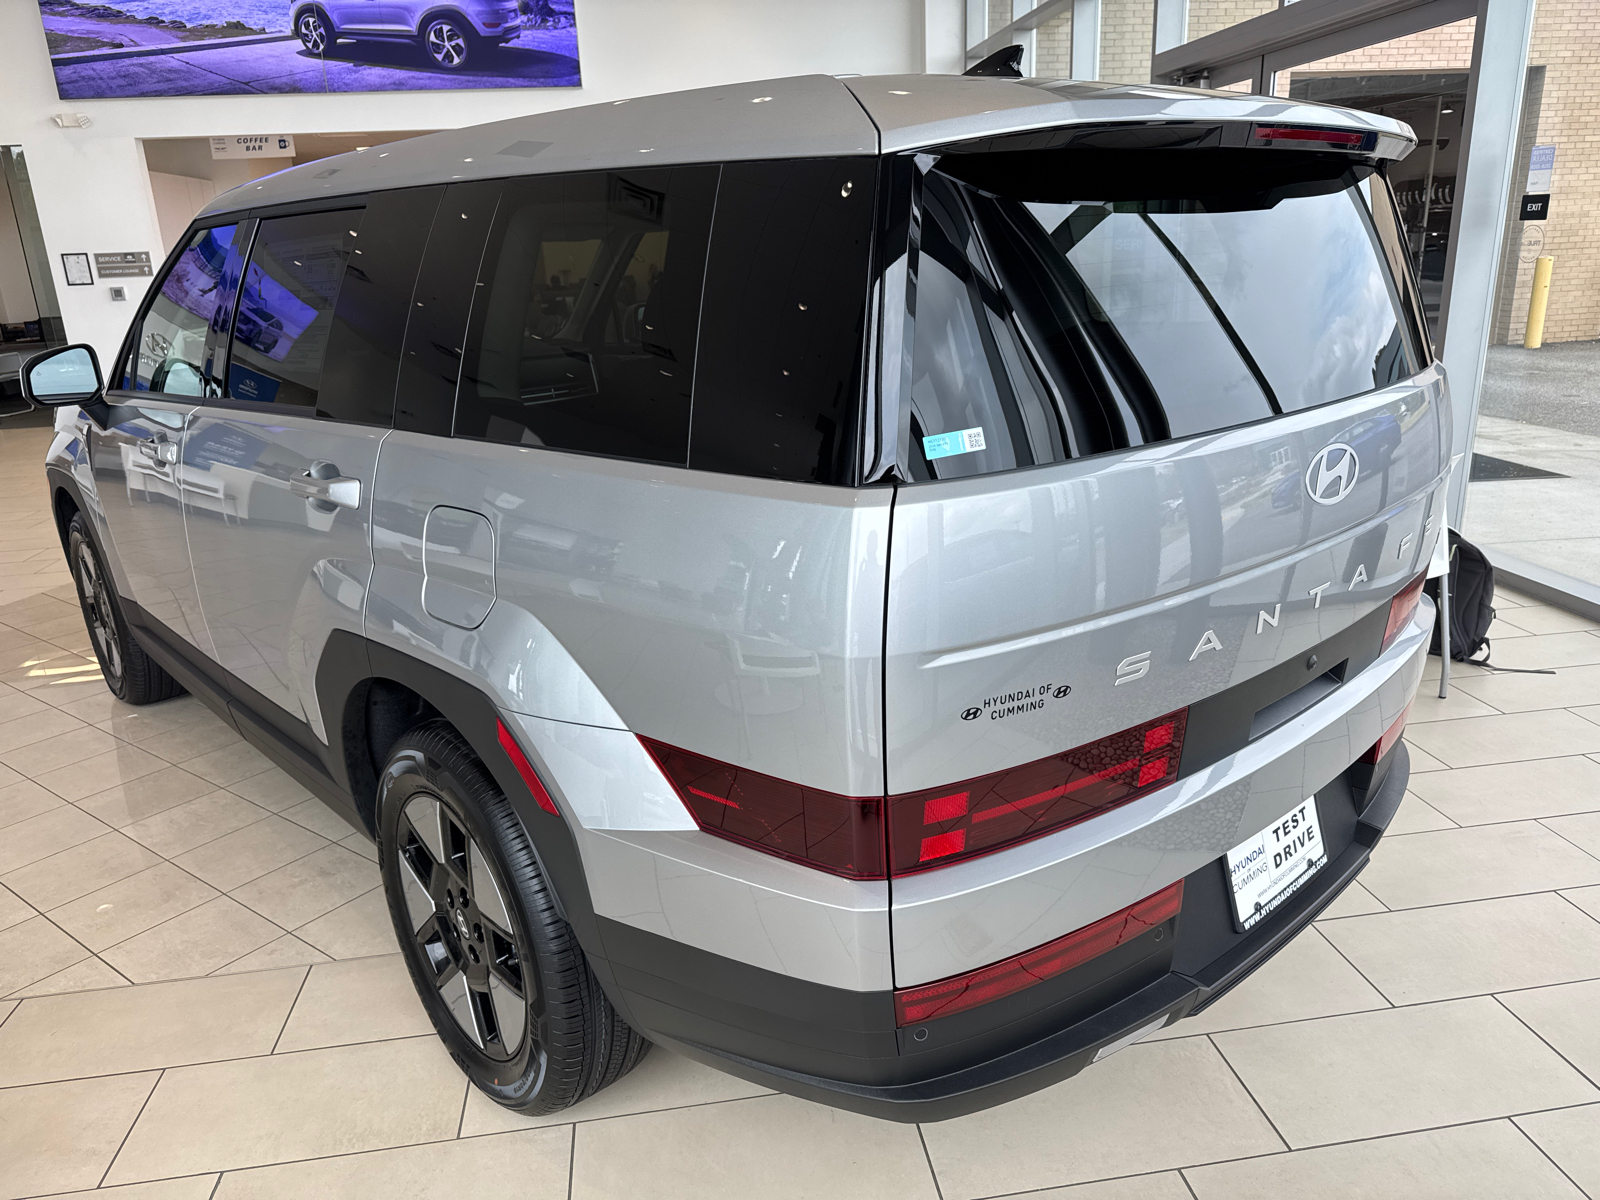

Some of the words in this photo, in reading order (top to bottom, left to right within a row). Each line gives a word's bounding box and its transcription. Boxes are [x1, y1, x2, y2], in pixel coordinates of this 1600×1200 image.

[236, 136, 270, 145] COFFEE
[245, 144, 263, 152] BAR
[1527, 202, 1543, 212] EXIT
[1114, 563, 1368, 687] SANTA
[1397, 513, 1435, 560] FE
[983, 688, 1035, 709] HYUNDAI
[1038, 683, 1053, 696] OF
[990, 699, 1045, 720] CUMMING
[1272, 805, 1307, 843] TEST
[1230, 844, 1266, 876] HYUNDAI
[1272, 825, 1315, 870] DRIVE
[1232, 861, 1269, 894] CUMMING
[1243, 853, 1329, 931] WWW.HYUNDAIOFCUMMING.COM
